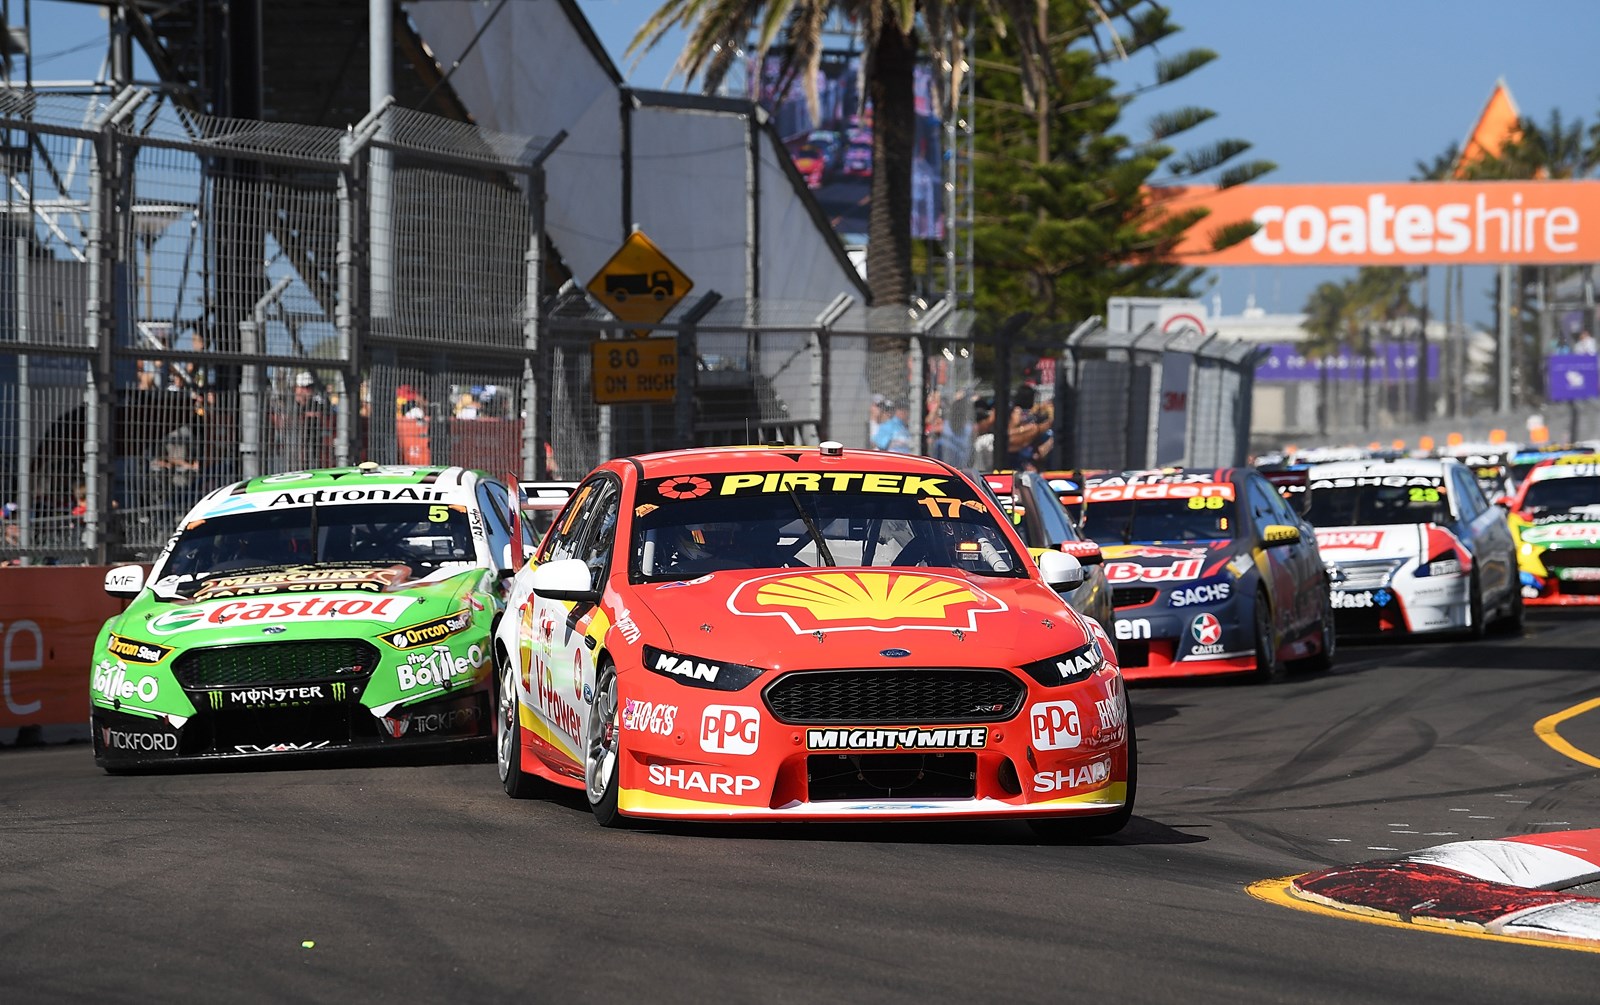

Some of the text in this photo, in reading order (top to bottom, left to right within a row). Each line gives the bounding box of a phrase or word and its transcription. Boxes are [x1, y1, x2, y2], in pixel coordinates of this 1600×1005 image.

[609, 348, 640, 369] 80
[604, 373, 676, 394] ON RIGH
[719, 472, 950, 497] PIRTEK
[268, 486, 449, 508] ActronAir
[917, 497, 962, 518] 17
[1188, 496, 1224, 510] 88
[428, 505, 449, 522] 5
[217, 570, 373, 587] MERCURY
[1106, 560, 1205, 584] Bull
[288, 582, 380, 592] CIDER
[1169, 582, 1231, 607] SACHS
[208, 597, 395, 624] Castrol
[406, 623, 450, 644] Orrcon
[1114, 618, 1152, 641] en
[137, 645, 162, 662] Steel
[406, 652, 427, 665] the
[1191, 643, 1225, 656] CALTEX
[0, 619, 44, 716] e
[655, 653, 721, 683] MAN
[1057, 650, 1103, 679] MAN
[230, 686, 324, 704] MONSTER
[535, 654, 584, 749] V-Power
[703, 710, 758, 749] PPG
[1033, 705, 1079, 746] PPG
[648, 763, 762, 796] SHARP
[1034, 758, 1112, 792] SHARP
